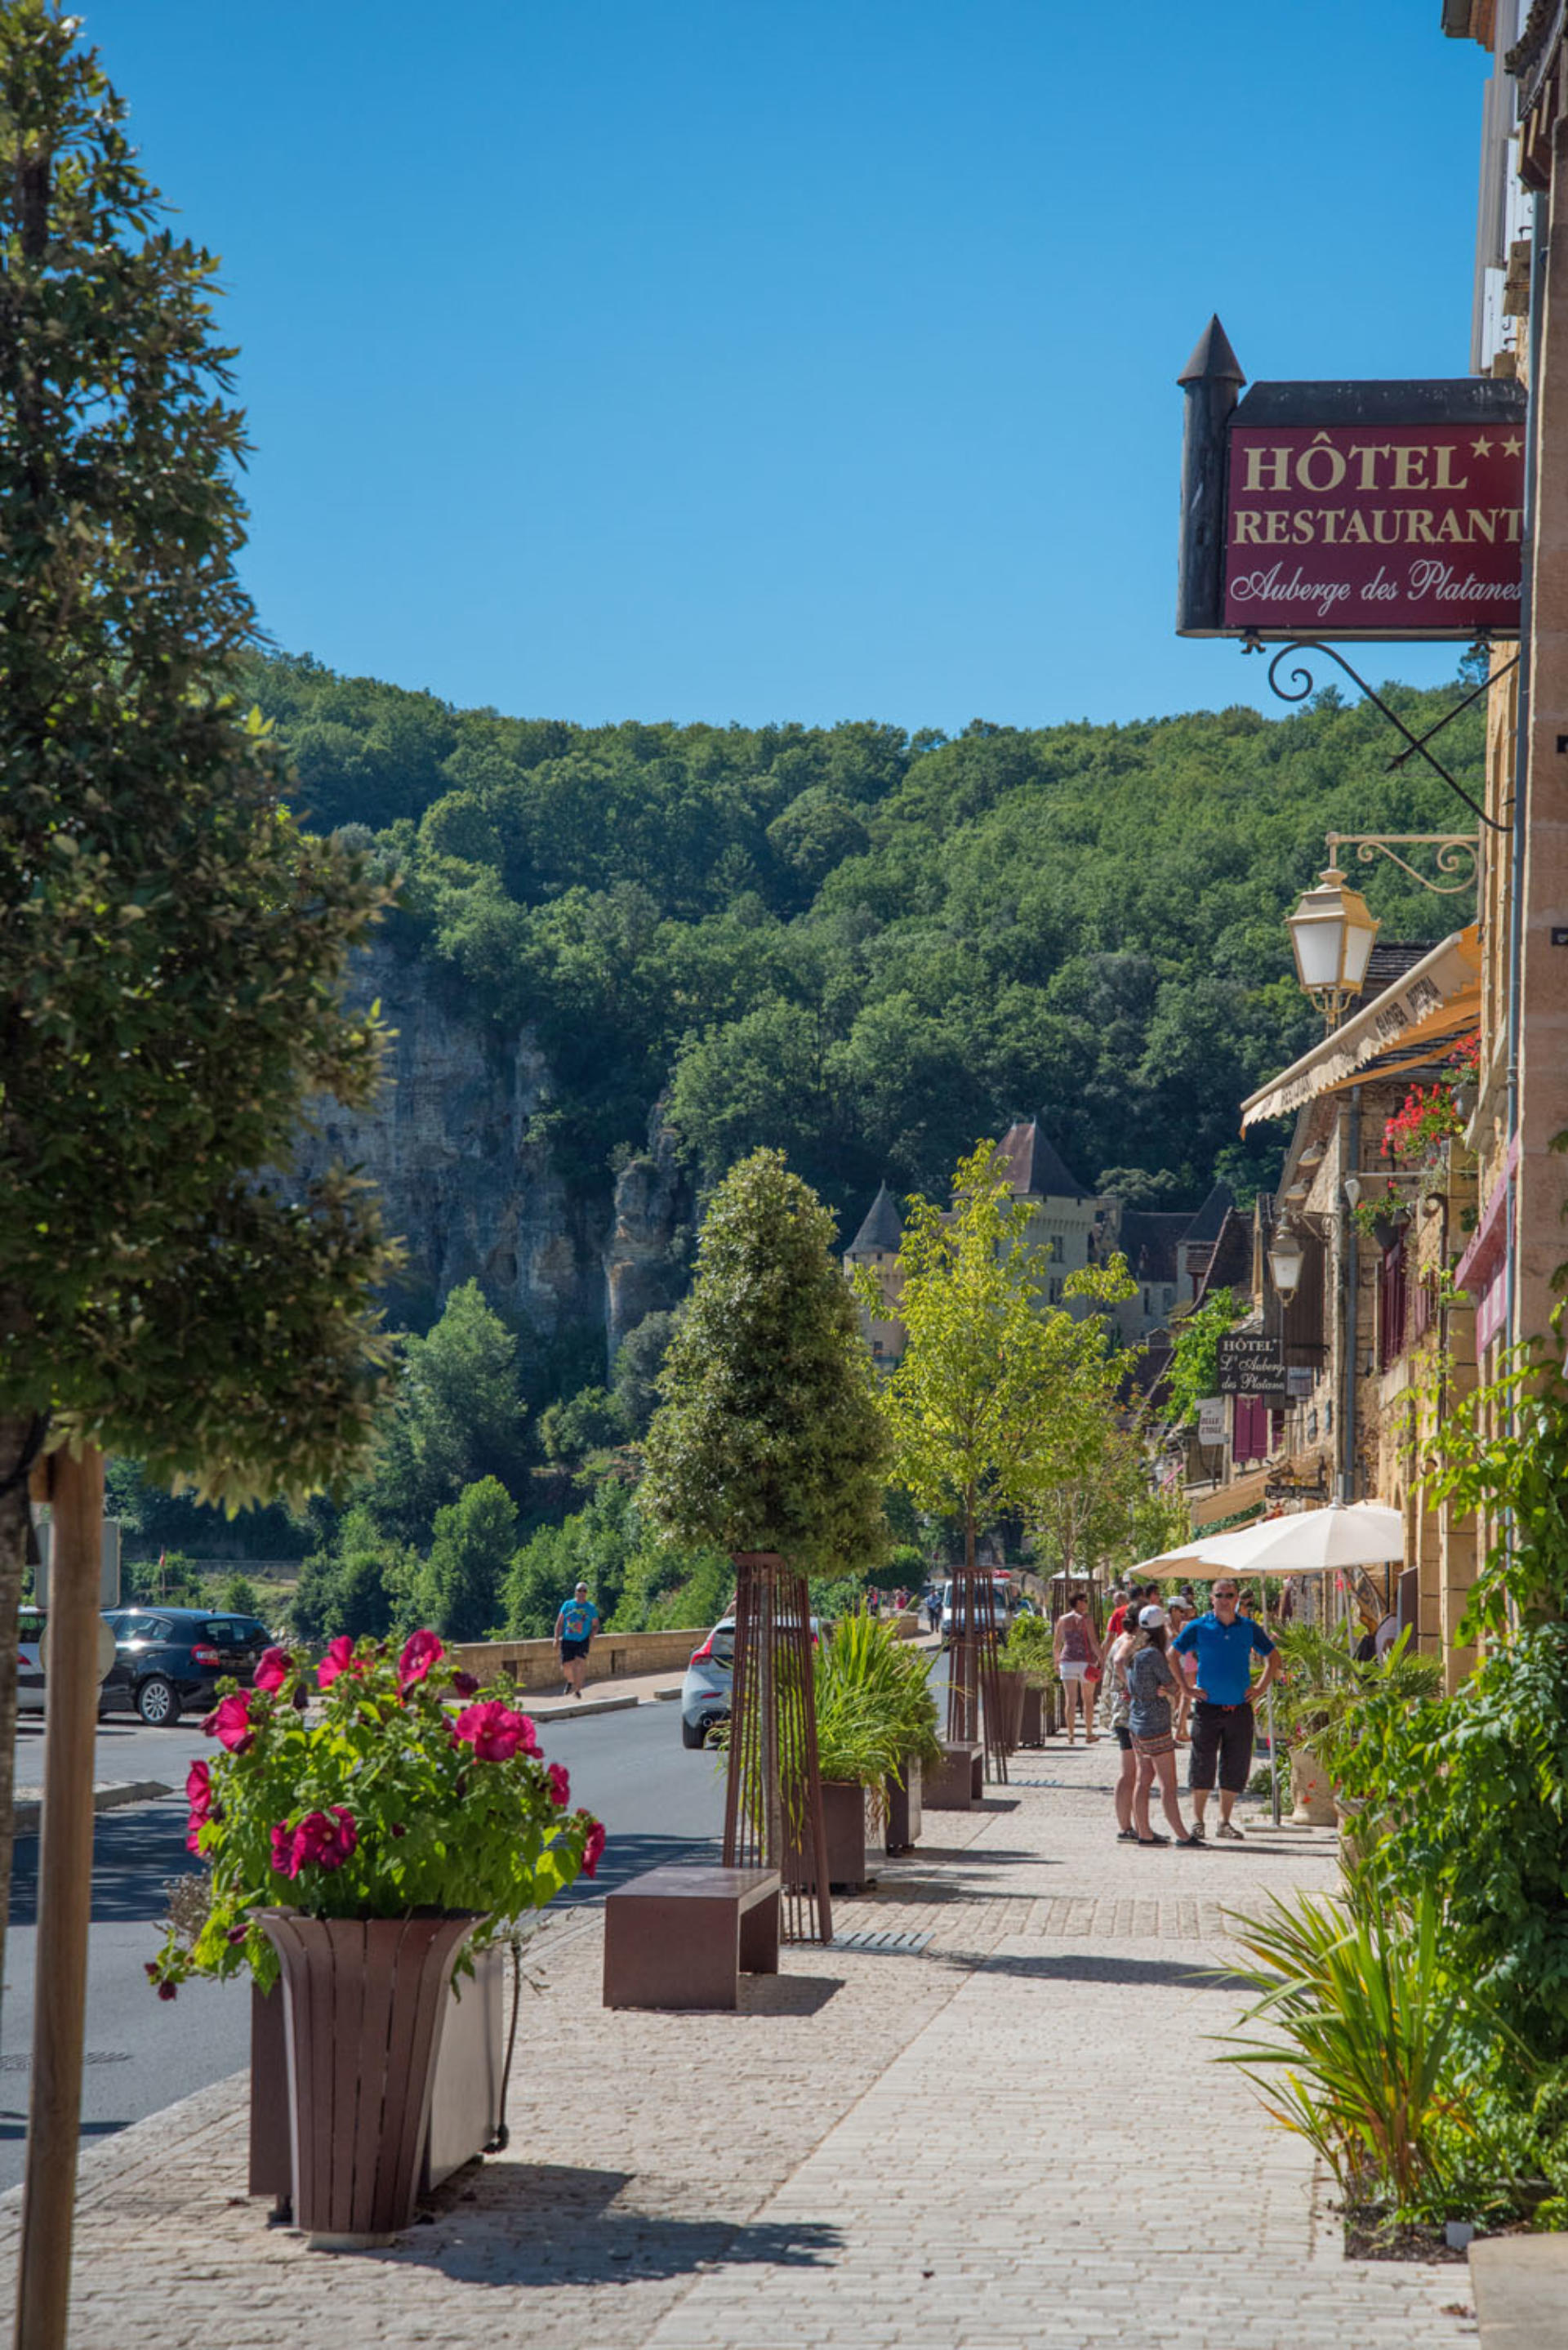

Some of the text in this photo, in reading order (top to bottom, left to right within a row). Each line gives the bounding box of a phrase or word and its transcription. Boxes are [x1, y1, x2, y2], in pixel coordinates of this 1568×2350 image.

[1242, 430, 1468, 492] HÔTEL
[1232, 507, 1524, 544] RESTAURANT
[1230, 559, 1522, 617] Auberge des Platanes
[1223, 1338, 1274, 1351] HÔTEL
[1222, 1376, 1236, 1389] des
